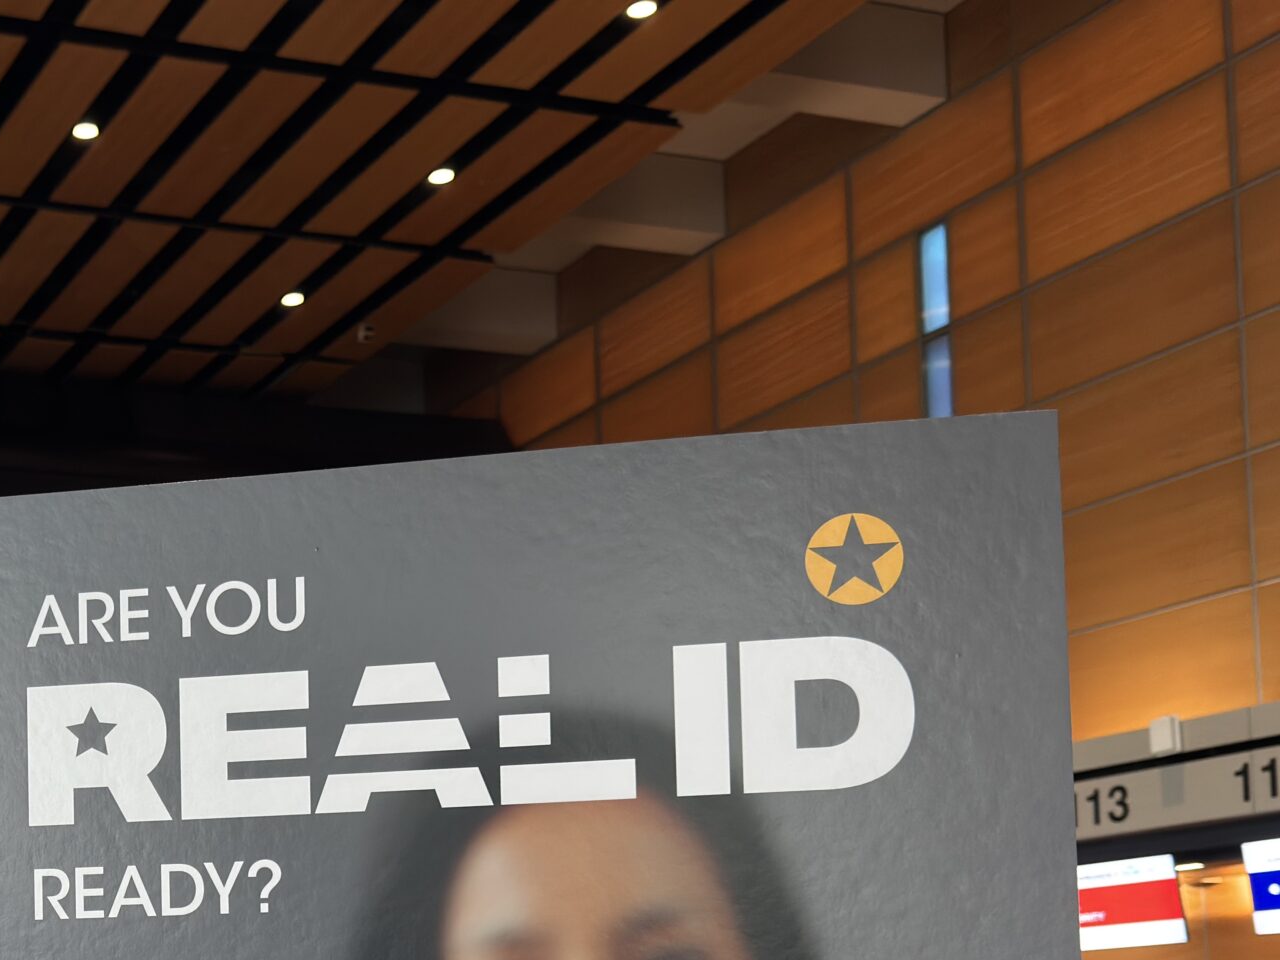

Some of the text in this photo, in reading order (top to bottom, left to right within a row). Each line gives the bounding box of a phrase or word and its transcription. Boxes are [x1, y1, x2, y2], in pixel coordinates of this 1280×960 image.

[26, 576, 306, 648] ARE YOU
[26, 635, 916, 827] REAL ID
[33, 858, 282, 921] READY?
